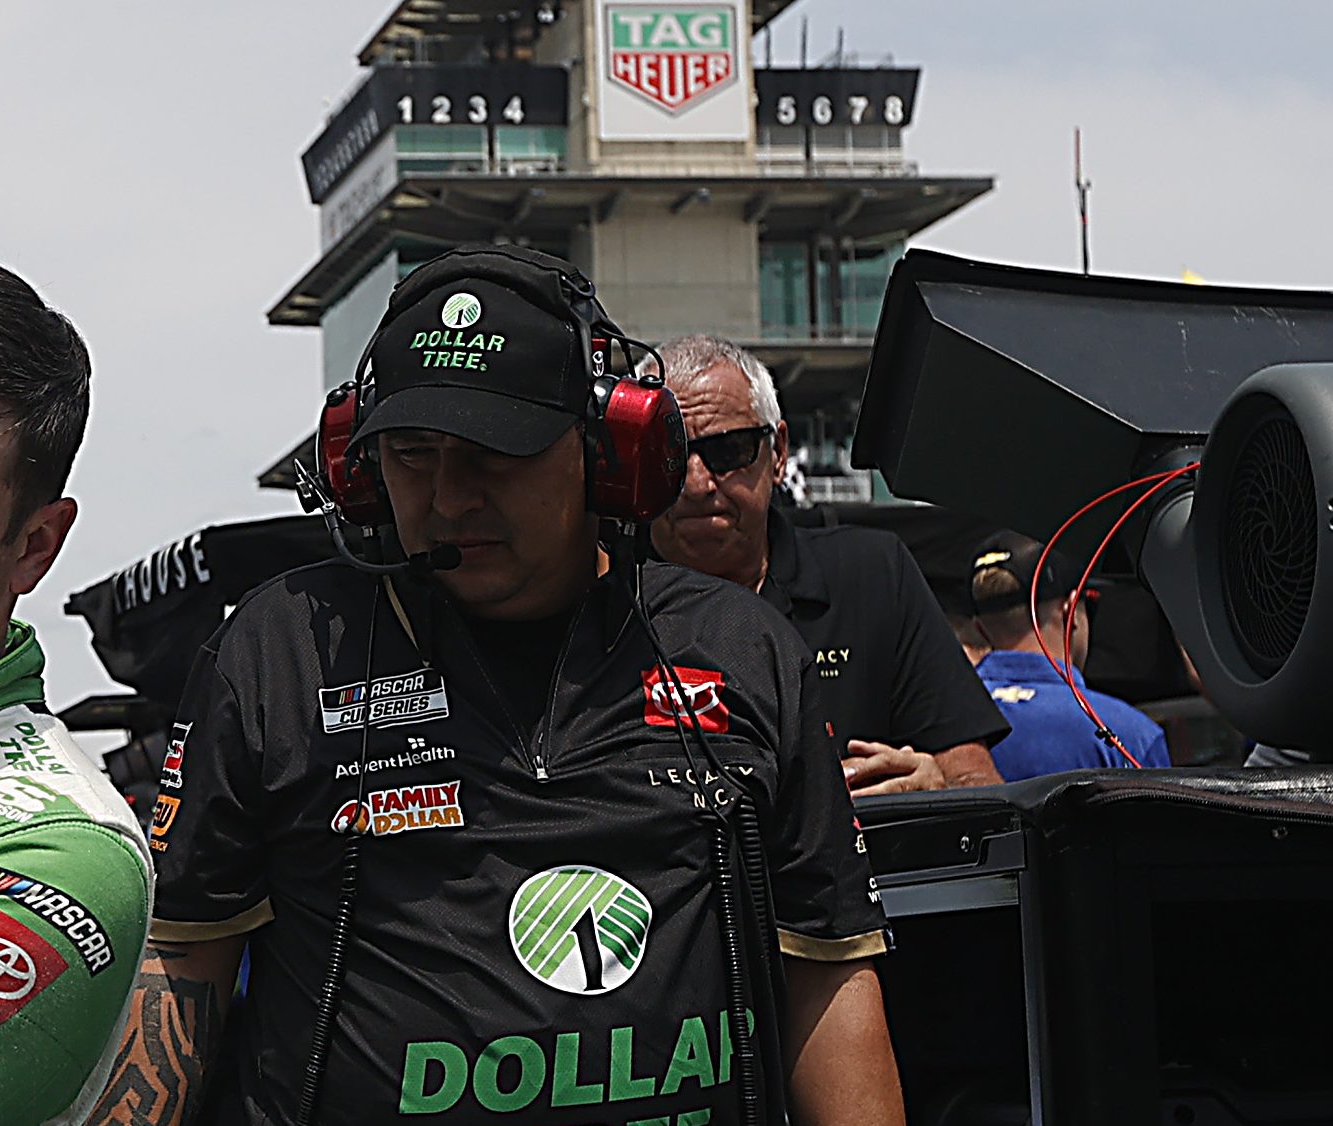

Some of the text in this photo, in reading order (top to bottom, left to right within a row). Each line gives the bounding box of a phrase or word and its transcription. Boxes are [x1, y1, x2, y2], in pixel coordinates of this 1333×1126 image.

[618, 14, 723, 47] TAG
[616, 53, 730, 104] HEUER
[397, 95, 525, 124] 1 2 3 4
[777, 95, 904, 125] 5 6 7 8
[409, 330, 506, 352] DOLLAR
[359, 674, 425, 701] NASCAR
[372, 696, 431, 719] SERIES
[370, 782, 460, 814] FAMILY
[372, 806, 462, 835] DOLLAR
[18, 882, 114, 974] NASCAR
